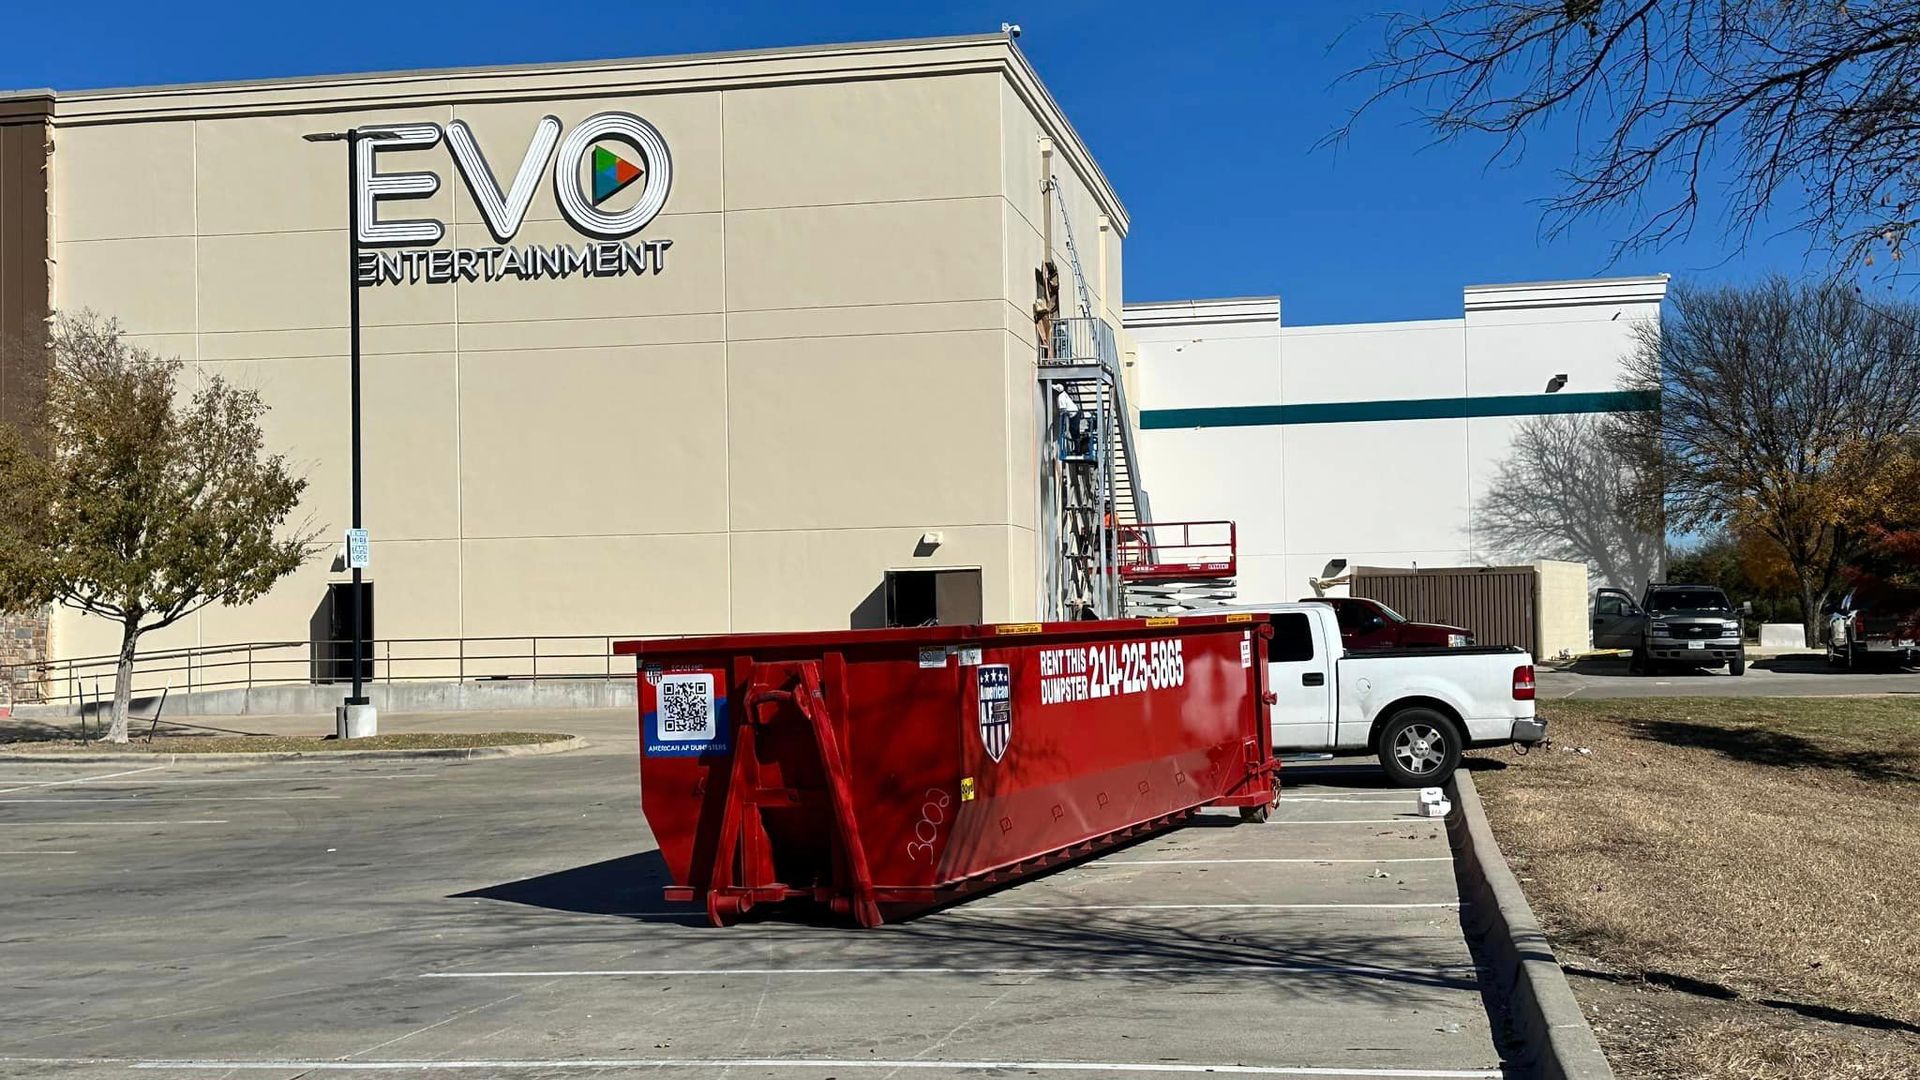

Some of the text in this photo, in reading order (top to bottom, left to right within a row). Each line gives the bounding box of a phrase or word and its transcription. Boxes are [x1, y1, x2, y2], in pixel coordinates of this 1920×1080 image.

[358, 111, 673, 246] EVO
[358, 240, 673, 286] ENTERTAINMENT
[1040, 647, 1086, 676] RENT THIS
[1089, 639, 1184, 698] 214-225-5865
[980, 683, 1009, 700] American
[1041, 676, 1089, 705] DUMPSTER
[648, 744, 680, 752] AMERICAN
[907, 787, 950, 865] 3002
